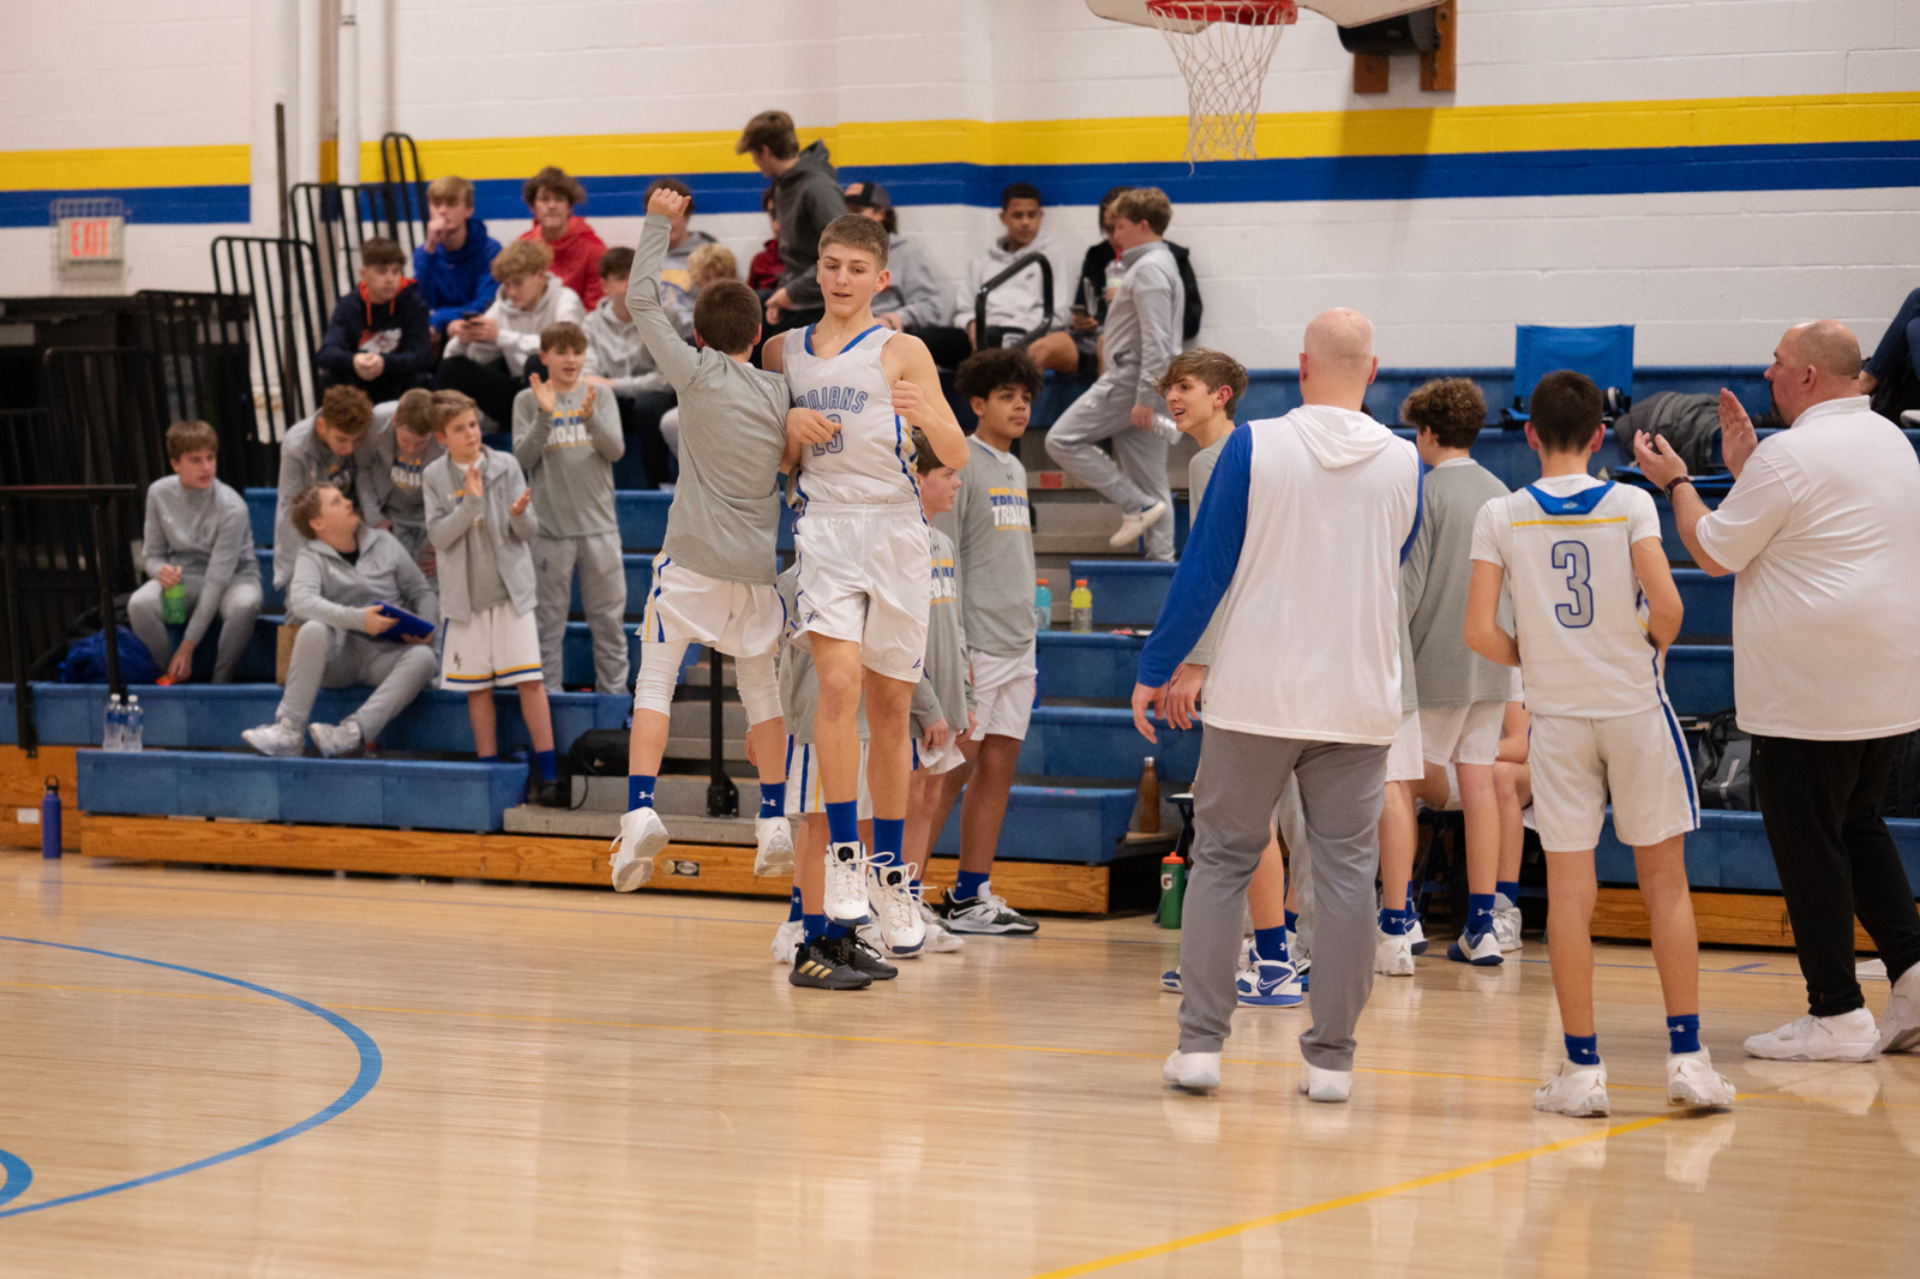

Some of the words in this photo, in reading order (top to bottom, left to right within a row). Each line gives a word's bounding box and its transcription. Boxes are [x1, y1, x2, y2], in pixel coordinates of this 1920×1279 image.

[71, 220, 108, 256] EXIT
[796, 386, 868, 414] ROJANS
[1551, 540, 1594, 629] 3
[1160, 873, 1173, 890] G
